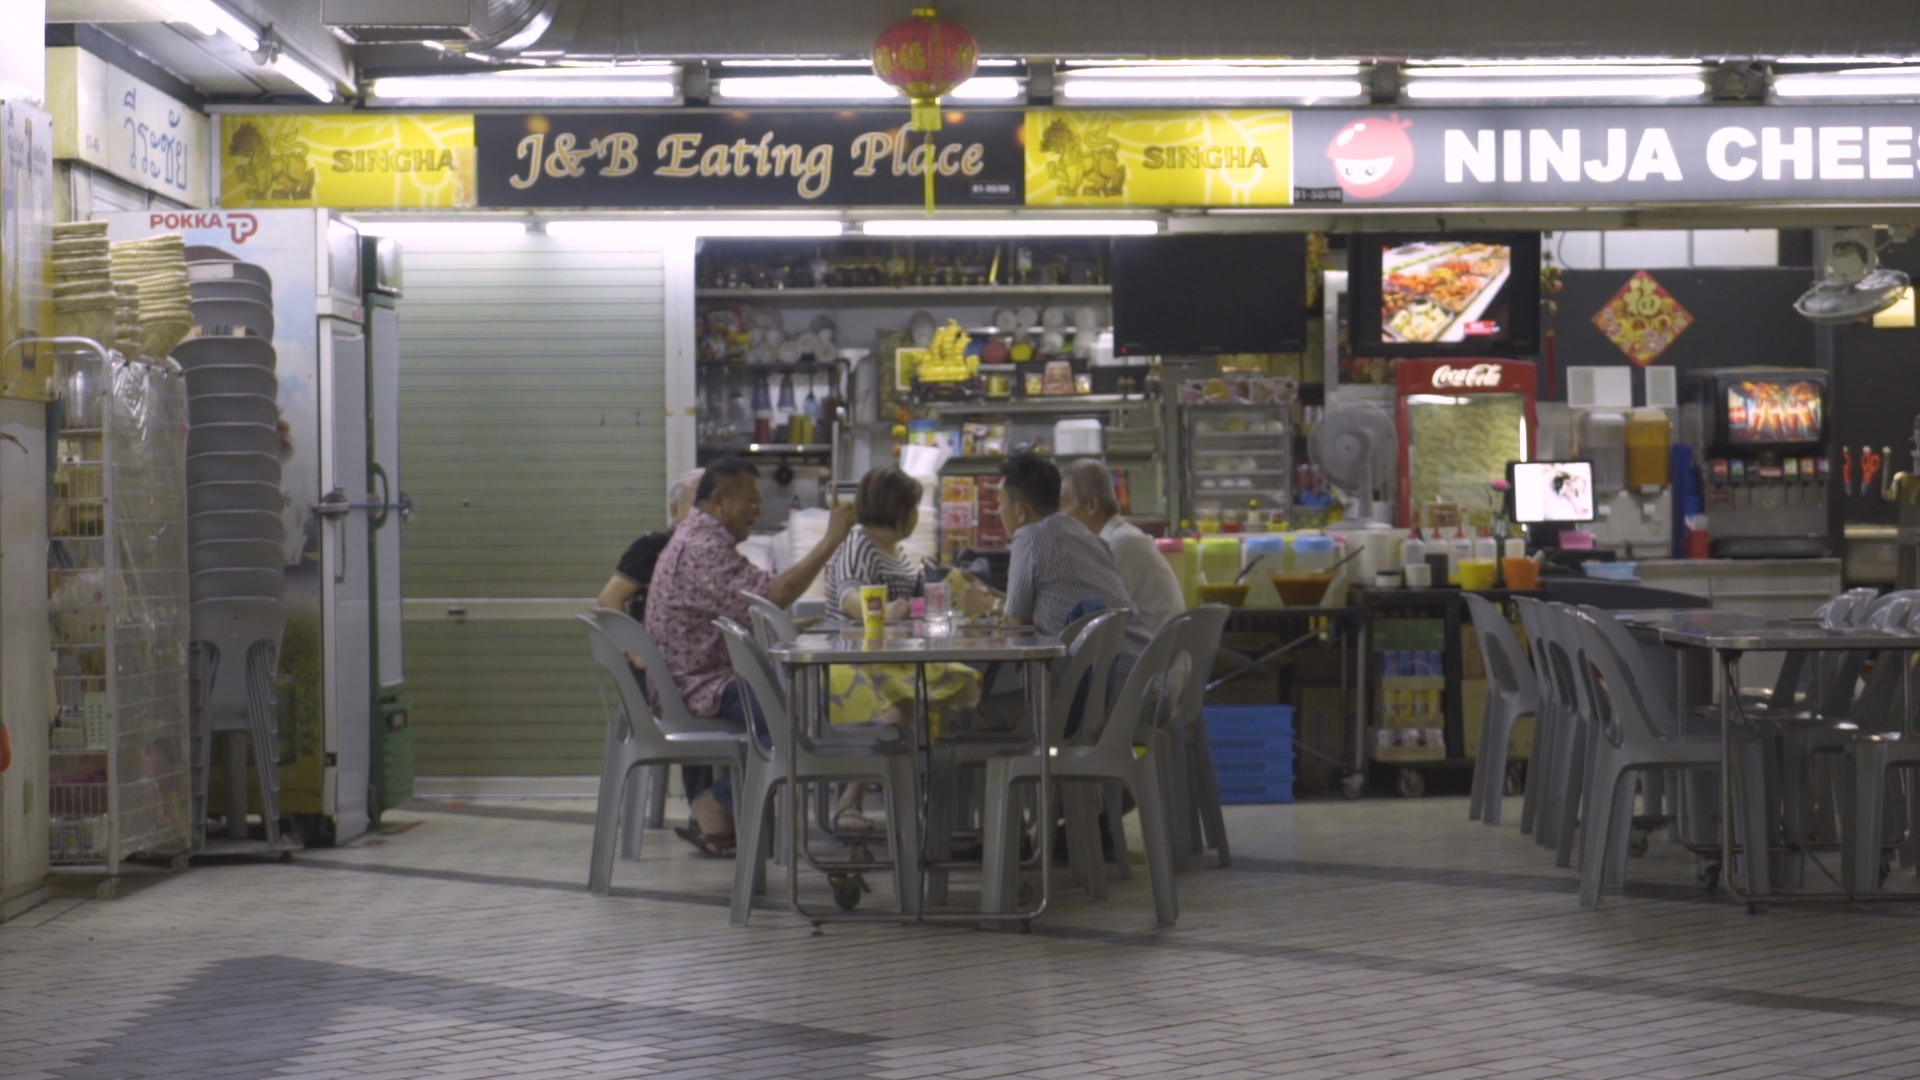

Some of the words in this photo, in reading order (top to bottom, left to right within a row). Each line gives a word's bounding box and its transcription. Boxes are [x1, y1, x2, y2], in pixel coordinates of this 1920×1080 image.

[331, 149, 458, 173] SINGHA
[509, 132, 639, 190] J&B
[653, 130, 834, 200] Eating
[850, 121, 985, 177] Place
[1142, 145, 1270, 170] SINGHA
[1443, 127, 1684, 184] NINJA
[1705, 126, 1920, 181] CHEE
[150, 212, 224, 230] POKKA
